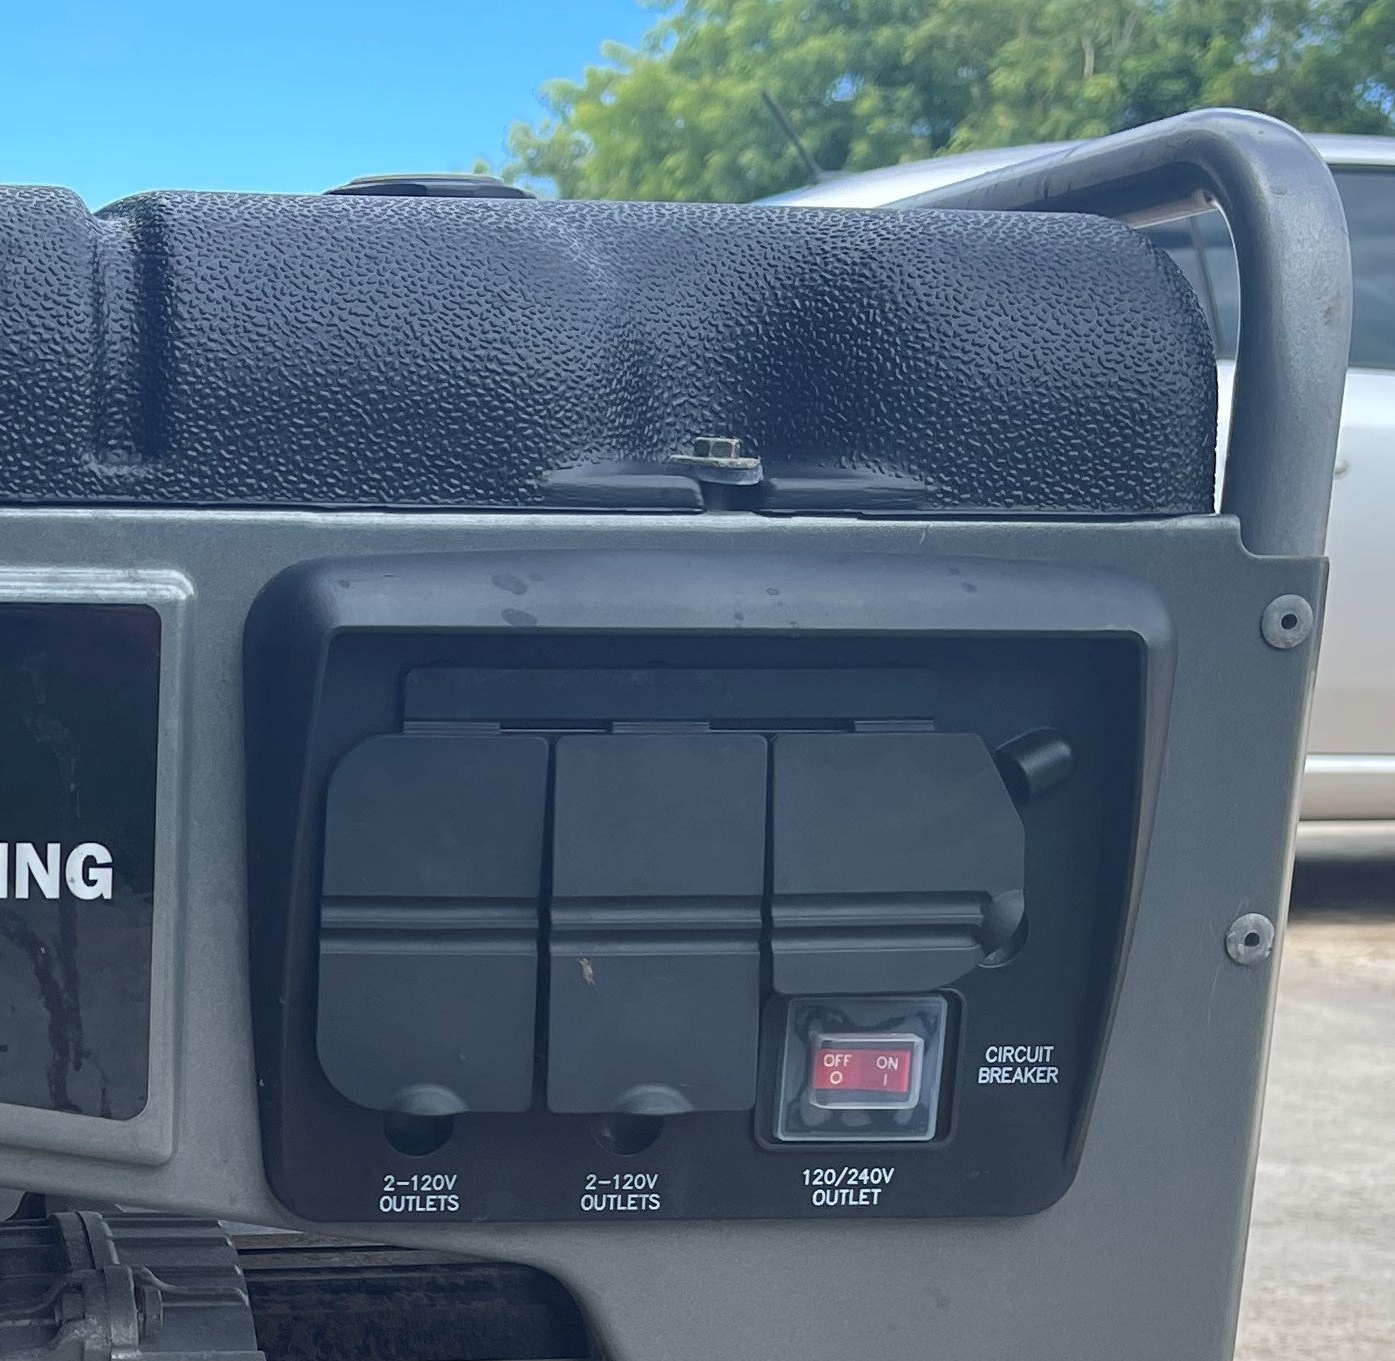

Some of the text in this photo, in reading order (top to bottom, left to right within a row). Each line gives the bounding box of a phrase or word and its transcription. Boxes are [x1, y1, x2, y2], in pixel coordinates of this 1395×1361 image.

[823, 1054, 852, 1067] OFF
[986, 1046, 1054, 1063] CIRCUIT
[876, 1056, 898, 1070] ON
[978, 1067, 1058, 1083] BREAKER
[384, 1175, 457, 1191] 2-120V
[585, 1174, 658, 1190] 2-120V
[802, 1168, 894, 1187] 120/240V
[380, 1195, 459, 1212] OUTLETS
[581, 1194, 660, 1210] OUTLETS
[813, 1189, 881, 1205] OUTLET
